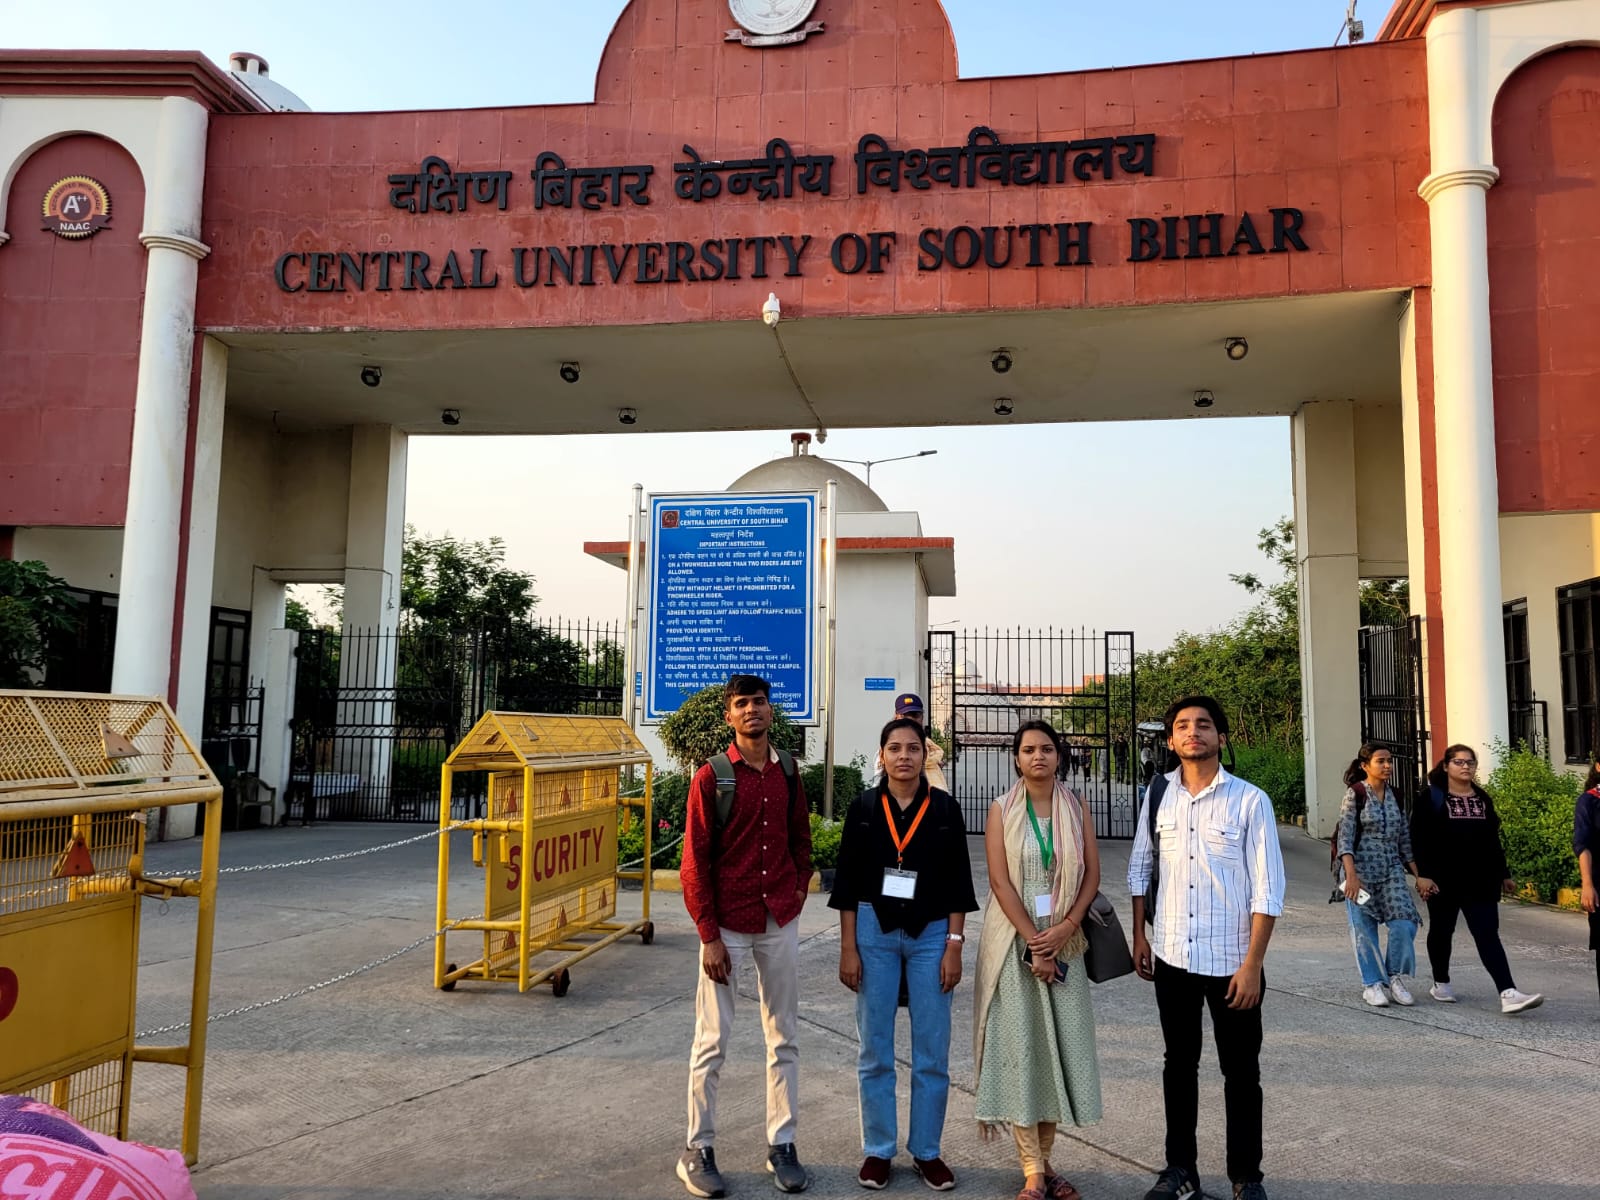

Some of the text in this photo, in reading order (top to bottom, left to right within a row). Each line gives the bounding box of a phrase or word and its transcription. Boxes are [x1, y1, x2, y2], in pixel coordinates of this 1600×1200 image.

[387, 126, 1156, 214] दक्षिण बिहार केन्द्रीय विश्वविद्यालय
[60, 222, 91, 231] NAAC
[274, 207, 1310, 292] CENTRAL UNIVERSITY OF SOUTH BIHAR
[705, 508, 720, 516] बिहार
[506, 825, 604, 892] SCURITY
